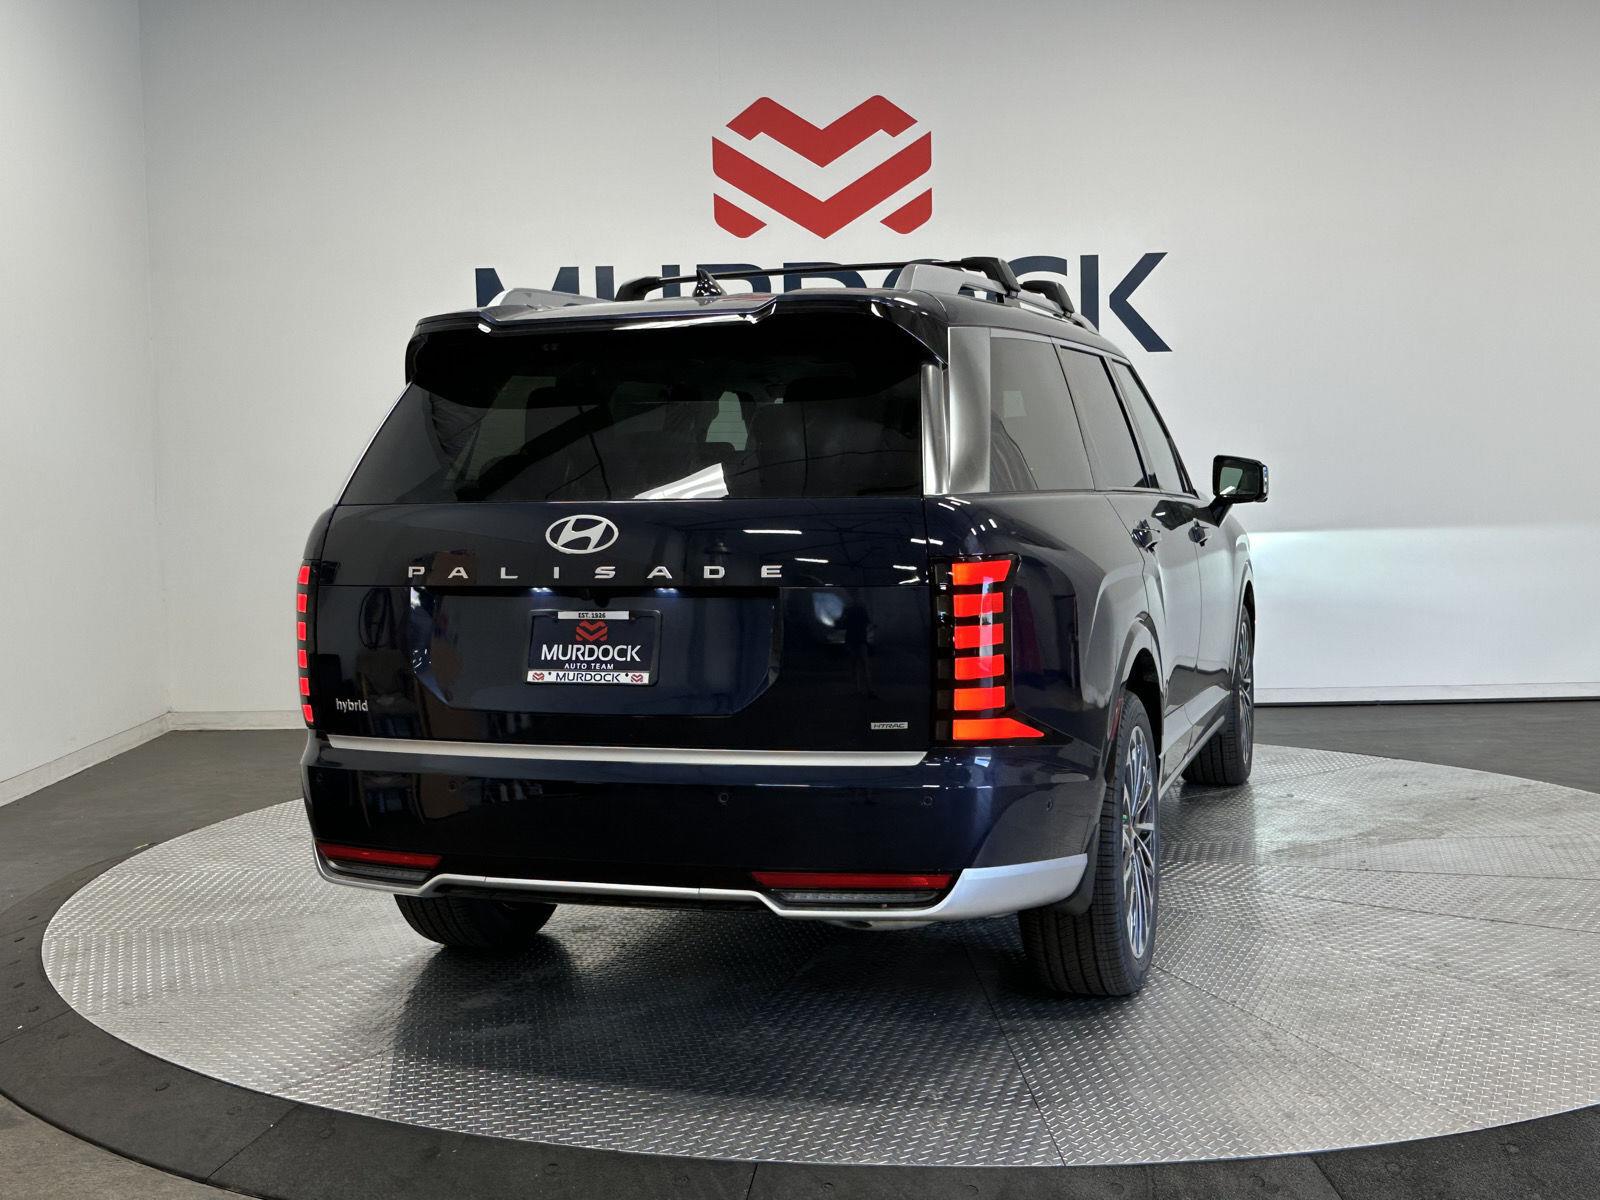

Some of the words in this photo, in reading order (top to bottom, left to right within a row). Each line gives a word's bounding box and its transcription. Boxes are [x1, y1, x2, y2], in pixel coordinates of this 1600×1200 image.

[408, 565, 783, 579] PALISADE
[541, 644, 641, 662] MURDOCK
[555, 672, 621, 682] MURDOCK
[335, 698, 369, 713] hybrid
